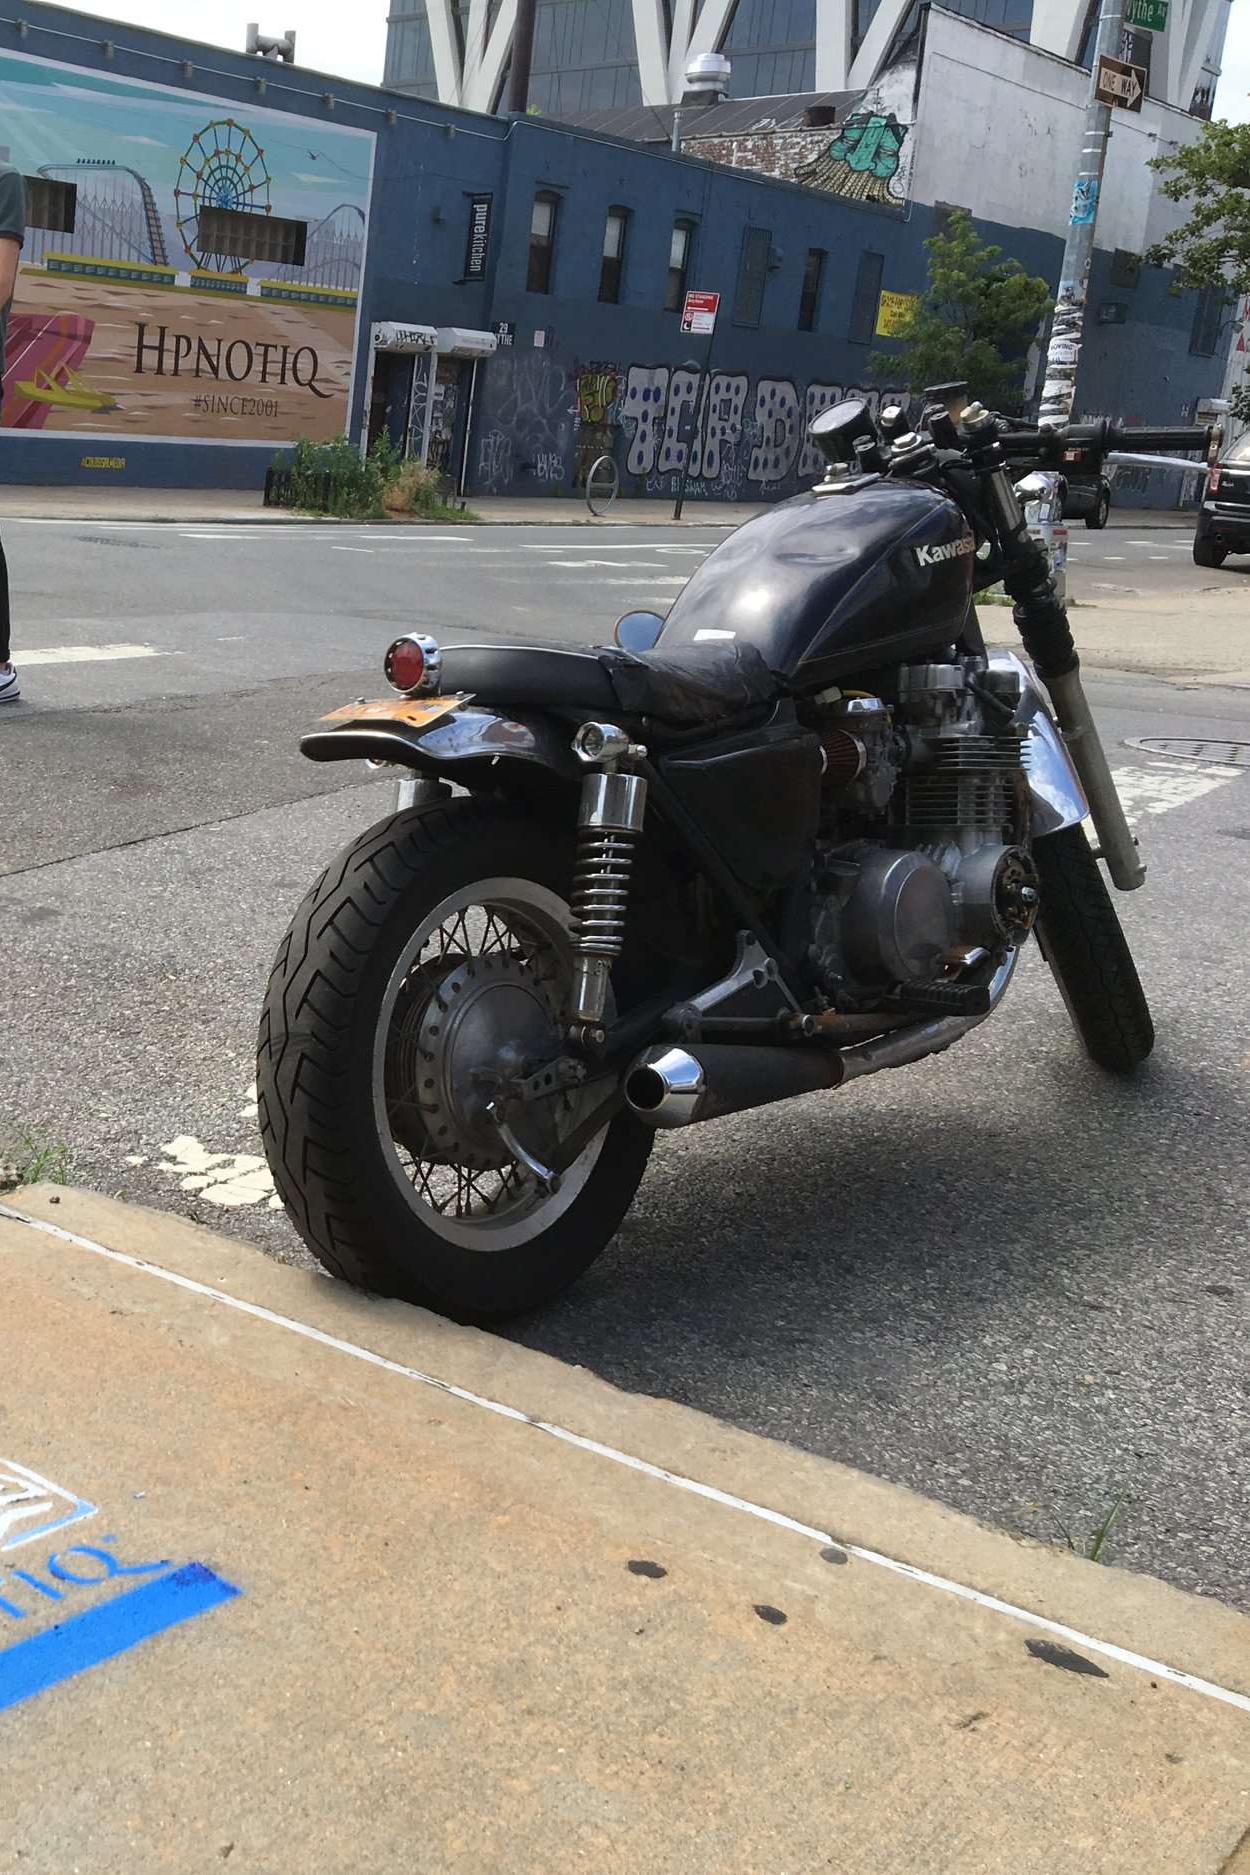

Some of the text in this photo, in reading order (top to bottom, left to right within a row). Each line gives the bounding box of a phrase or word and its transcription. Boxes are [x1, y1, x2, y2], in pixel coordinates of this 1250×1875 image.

[1102, 71, 1138, 98] ONE WAY
[470, 203, 488, 272] purekitchen
[496, 333, 514, 346] YTHE
[499, 322, 509, 334] 29
[133, 322, 334, 398] HPNOTIQ
[193, 395, 278, 418] #SINCE2001
